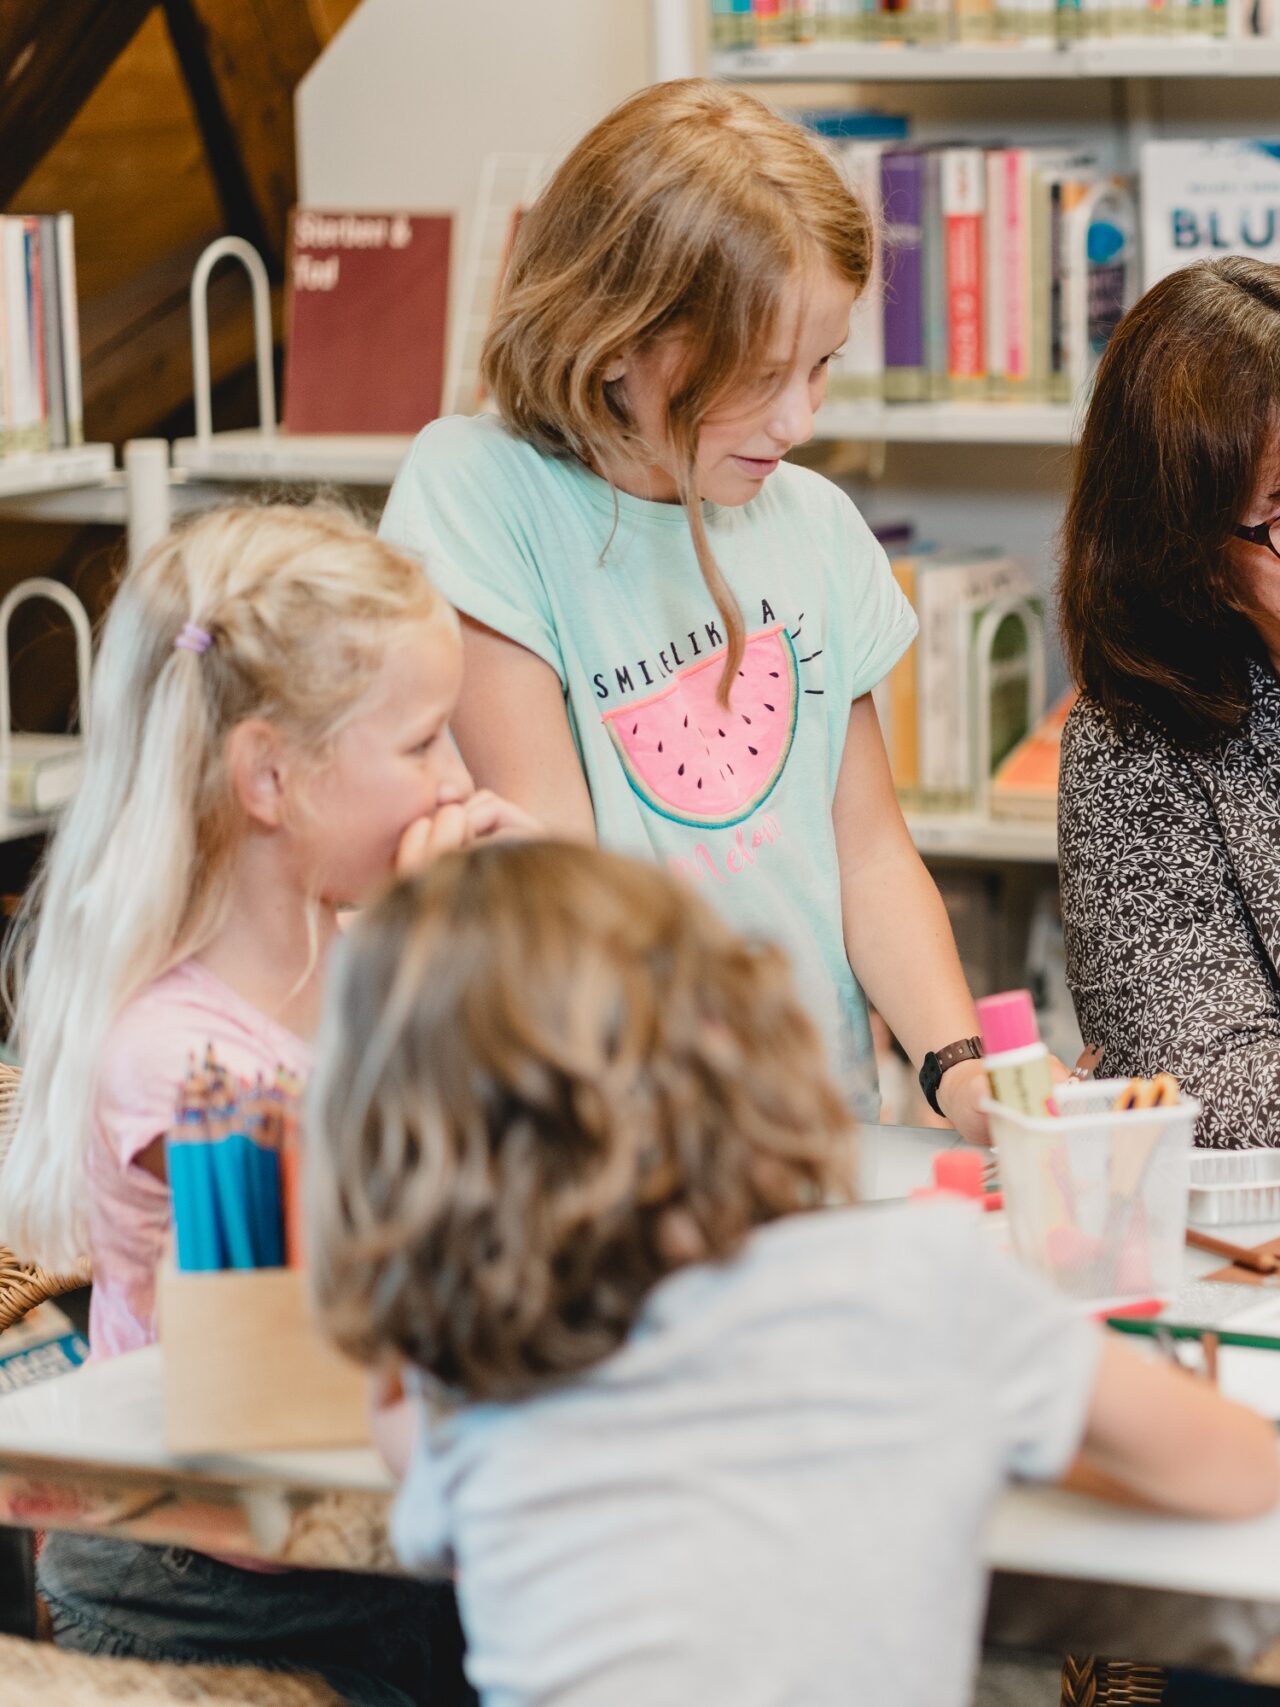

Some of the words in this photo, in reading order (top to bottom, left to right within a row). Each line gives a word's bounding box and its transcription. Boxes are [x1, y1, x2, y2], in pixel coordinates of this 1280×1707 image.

[593, 650, 673, 698] SMIE
[670, 621, 723, 665] LIK
[761, 598, 776, 624] A
